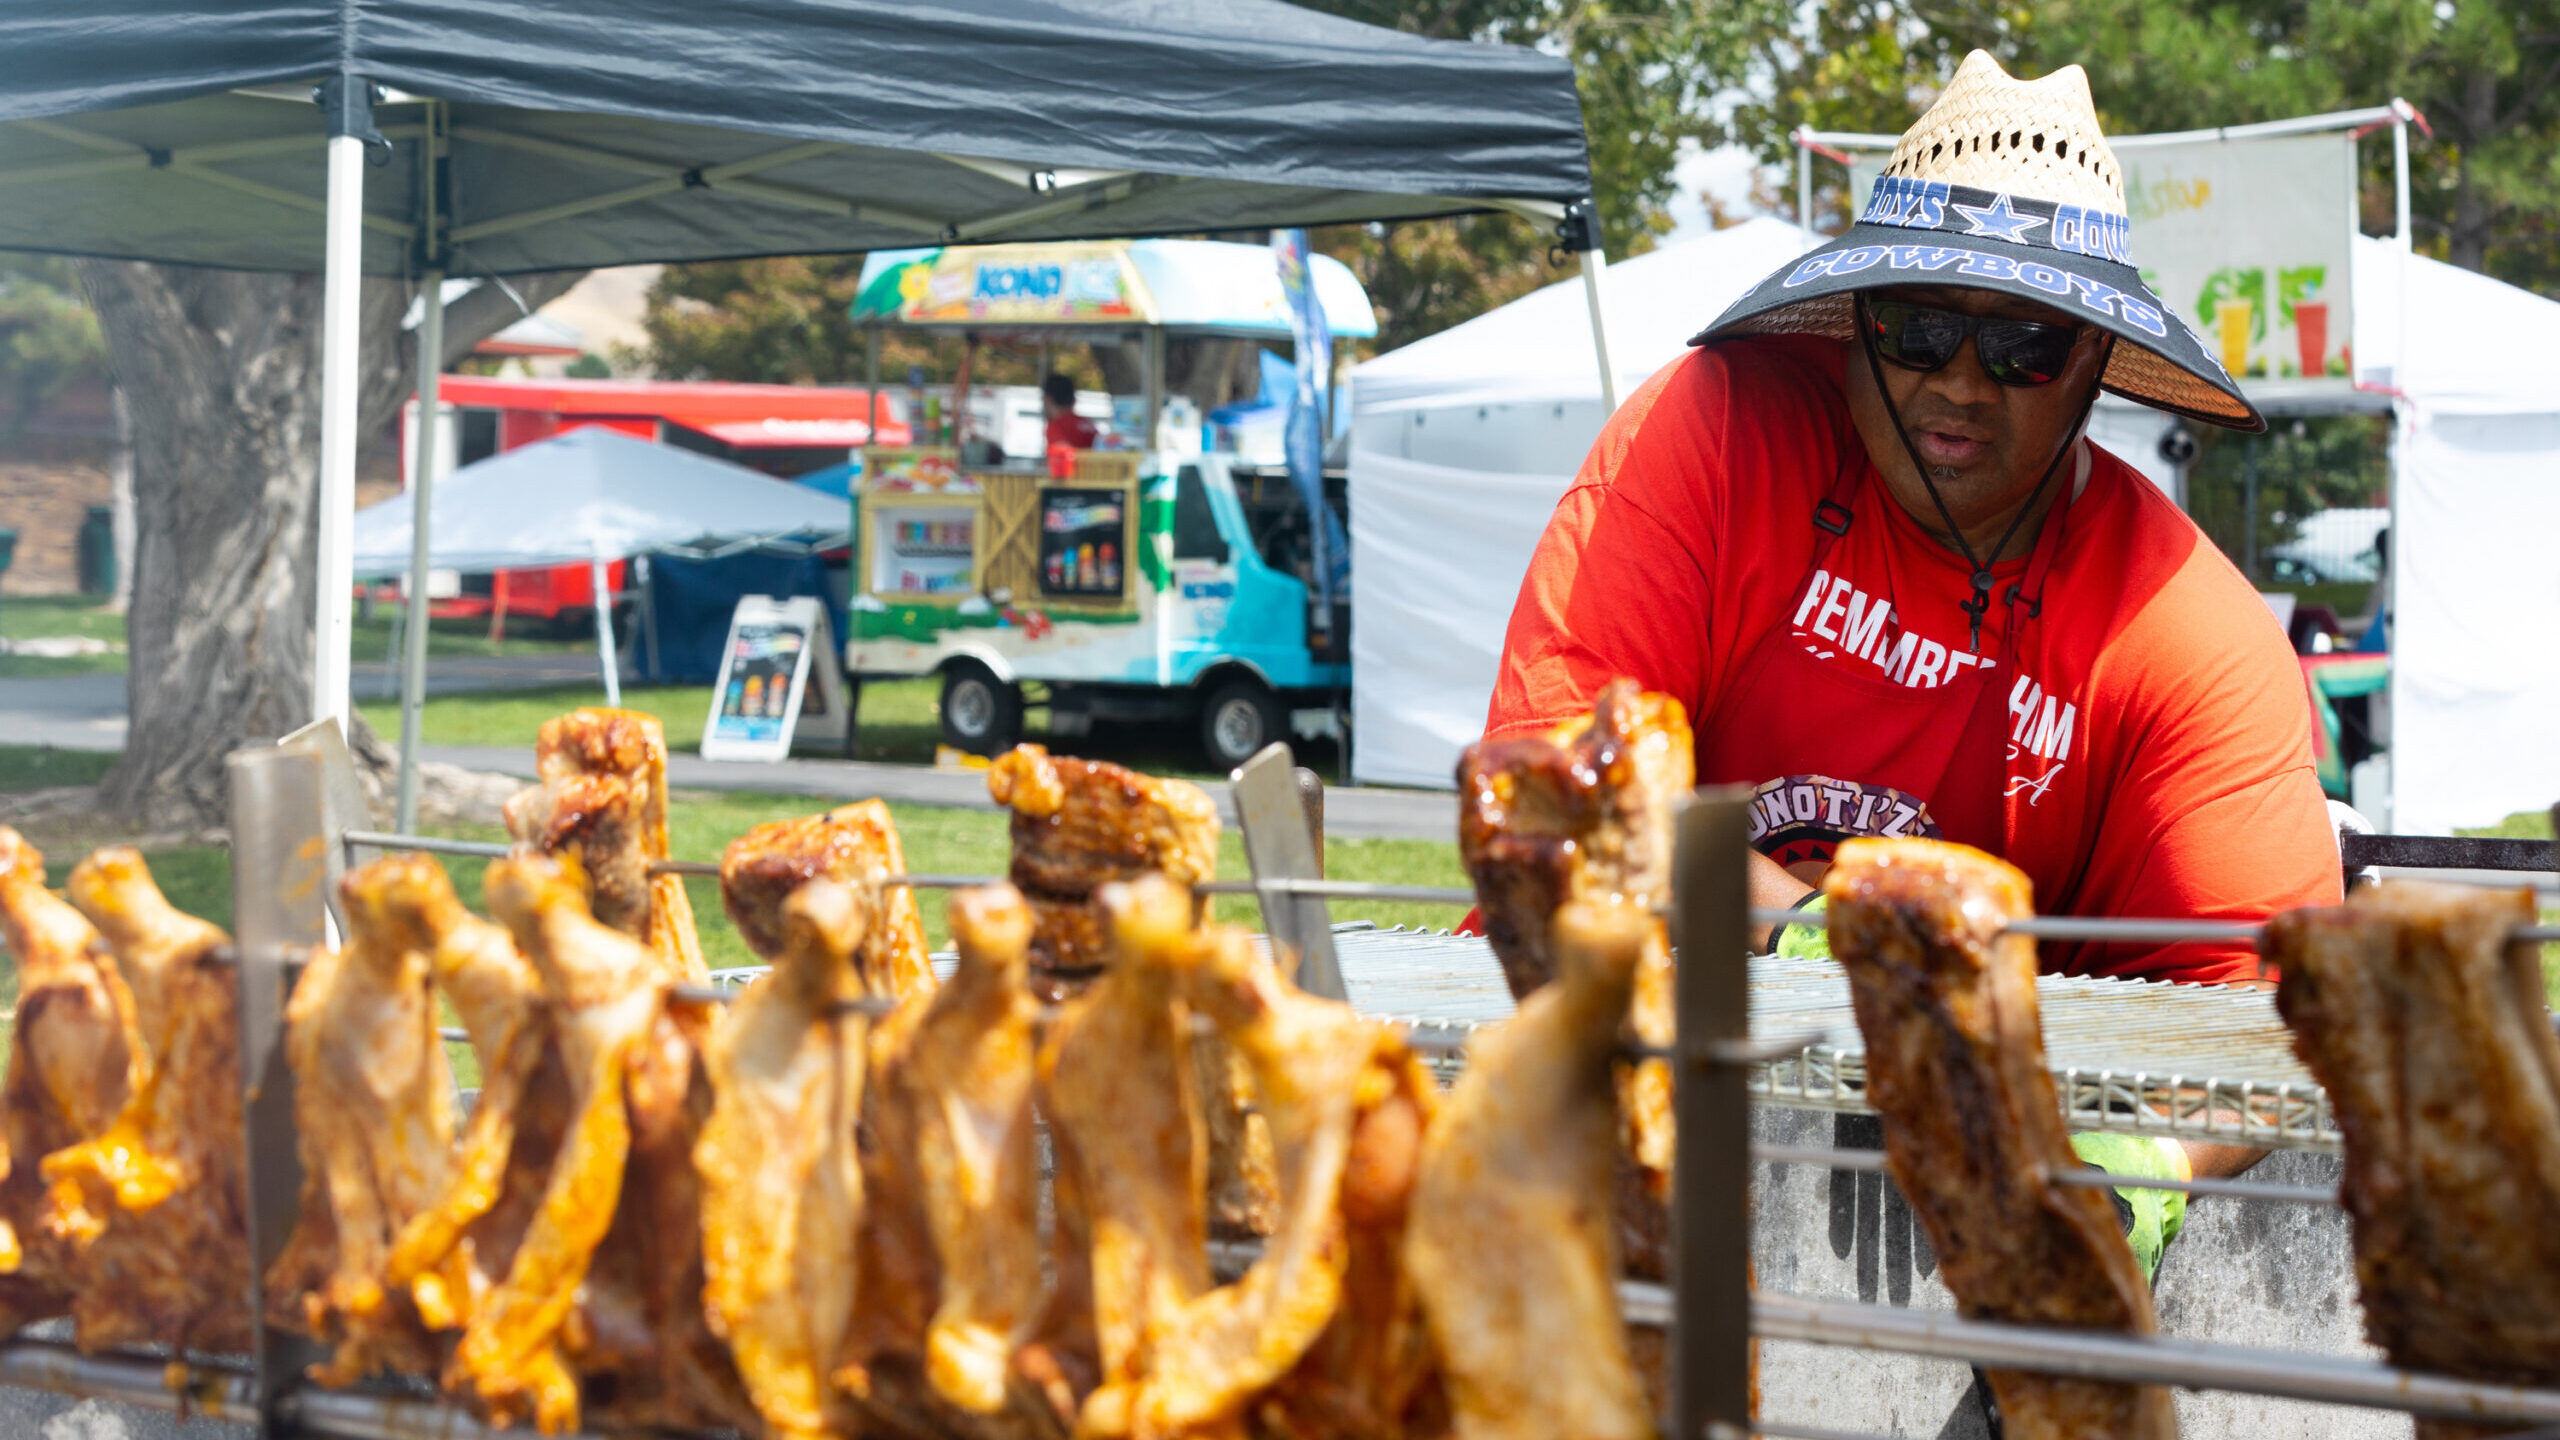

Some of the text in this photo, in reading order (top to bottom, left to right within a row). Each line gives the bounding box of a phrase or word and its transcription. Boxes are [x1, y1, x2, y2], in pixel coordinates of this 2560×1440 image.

[2051, 204, 2137, 269] COW
[975, 264, 1063, 301] KONA
[1783, 245, 2167, 337] COWBOYS
